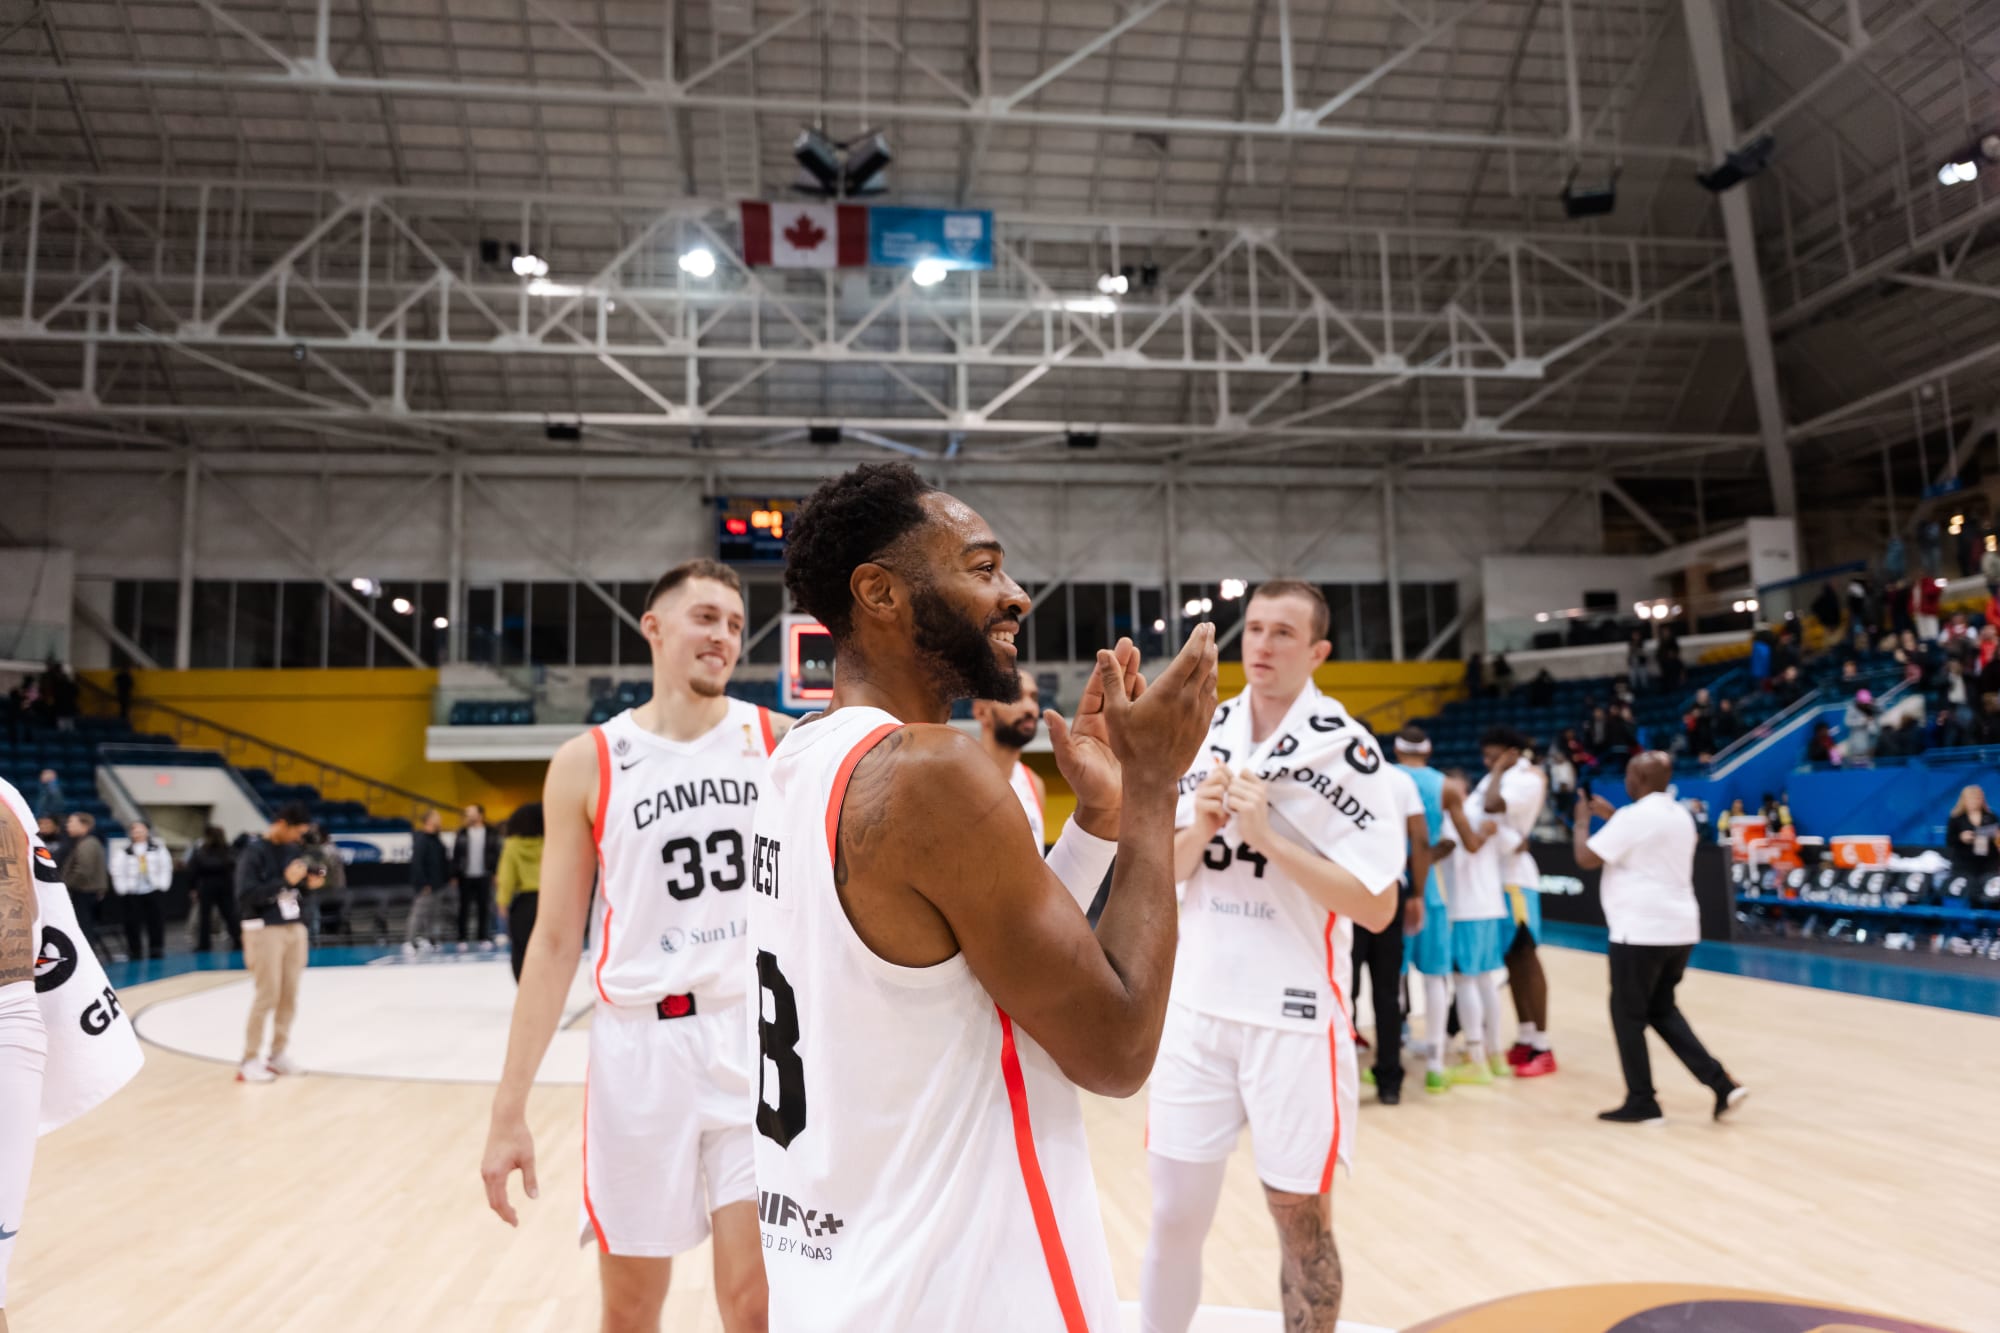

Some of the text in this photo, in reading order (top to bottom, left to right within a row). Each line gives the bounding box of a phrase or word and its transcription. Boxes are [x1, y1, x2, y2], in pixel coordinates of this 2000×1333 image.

[633, 778, 759, 830] CANADA
[661, 828, 746, 901] 33
[752, 833, 781, 899] BEST
[1210, 897, 1276, 920] Sun Life
[690, 927, 726, 945] Sun
[755, 946, 807, 1152] 8
[778, 1236, 797, 1253] BY
[800, 1242, 833, 1261] KDA3
